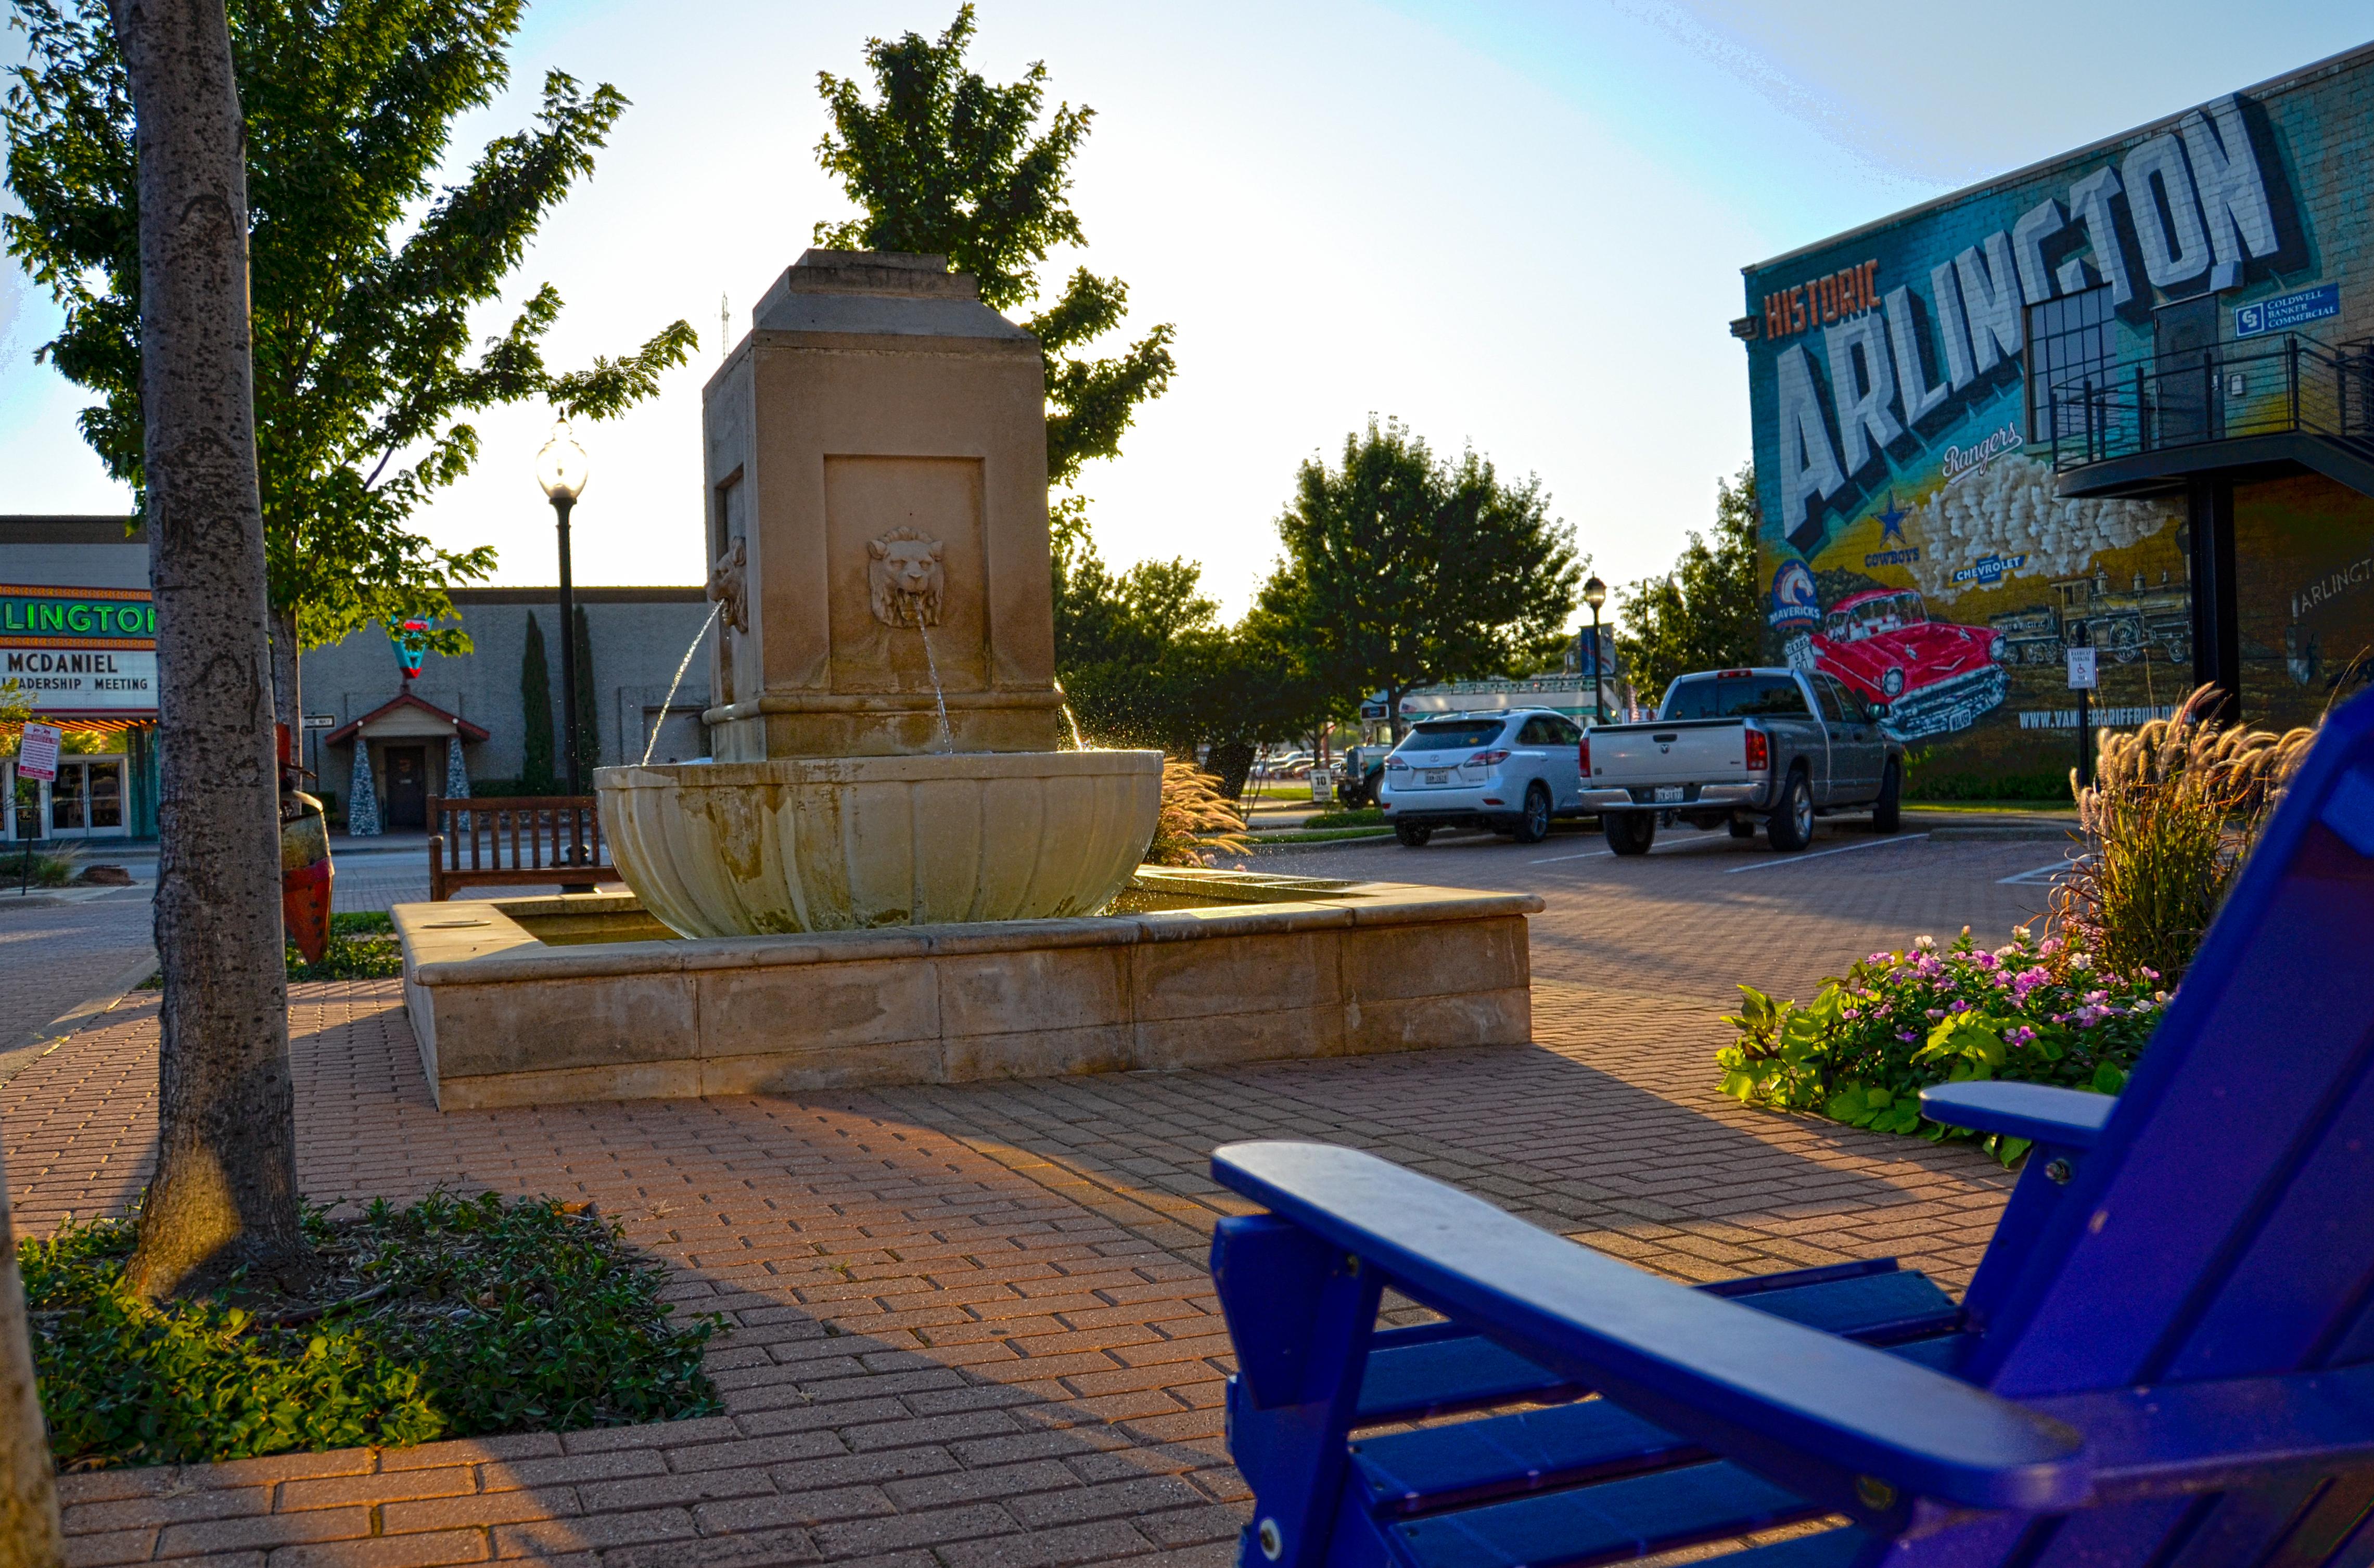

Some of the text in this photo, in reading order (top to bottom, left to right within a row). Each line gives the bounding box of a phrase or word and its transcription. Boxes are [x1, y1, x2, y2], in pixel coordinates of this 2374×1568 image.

[1765, 259, 1881, 341] HISTORIC
[2267, 290, 2324, 310] COLDWELL
[1777, 93, 2280, 541] ARLINGTON
[2268, 303, 2307, 319] BANKER
[2268, 306, 2335, 328] COMMERCIAL
[1943, 421, 2023, 482] Rangers
[1865, 547, 1920, 568] COWBOYS
[1957, 557, 2020, 581] CHEVROLET
[2302, 558, 2374, 614] ARLINGT
[1769, 606, 1820, 624] MAVERICKS
[1787, 637, 1808, 651] TEXAS
[8, 653, 118, 673] MCDANIEL
[95, 678, 148, 690] MEETING
[1316, 777, 1326, 786] 10
